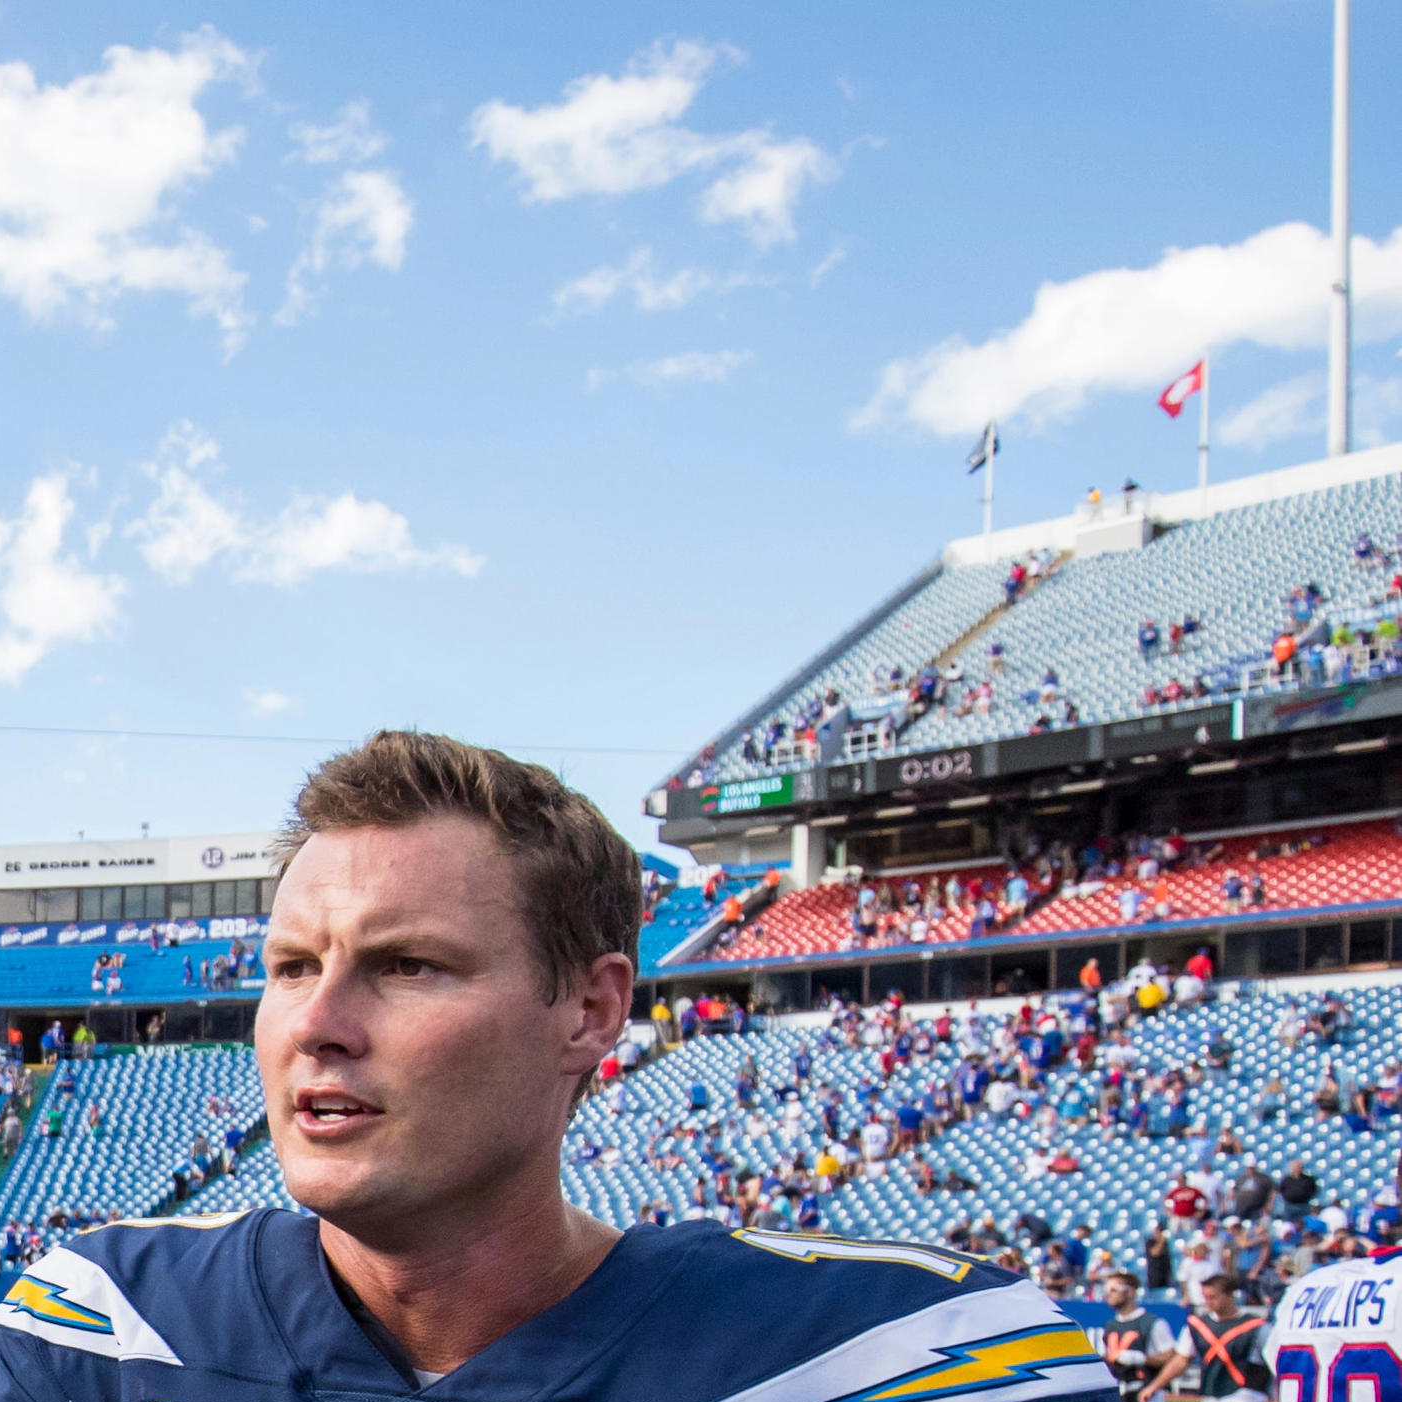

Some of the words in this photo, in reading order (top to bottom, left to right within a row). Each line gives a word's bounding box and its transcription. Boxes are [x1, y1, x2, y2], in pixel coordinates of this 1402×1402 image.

[900, 751, 972, 784] 0:02
[29, 859, 90, 871] GEORGE
[98, 857, 155, 868] SAIMES
[210, 918, 248, 938] 203
[1291, 1279, 1394, 1330] PHILLIPS
